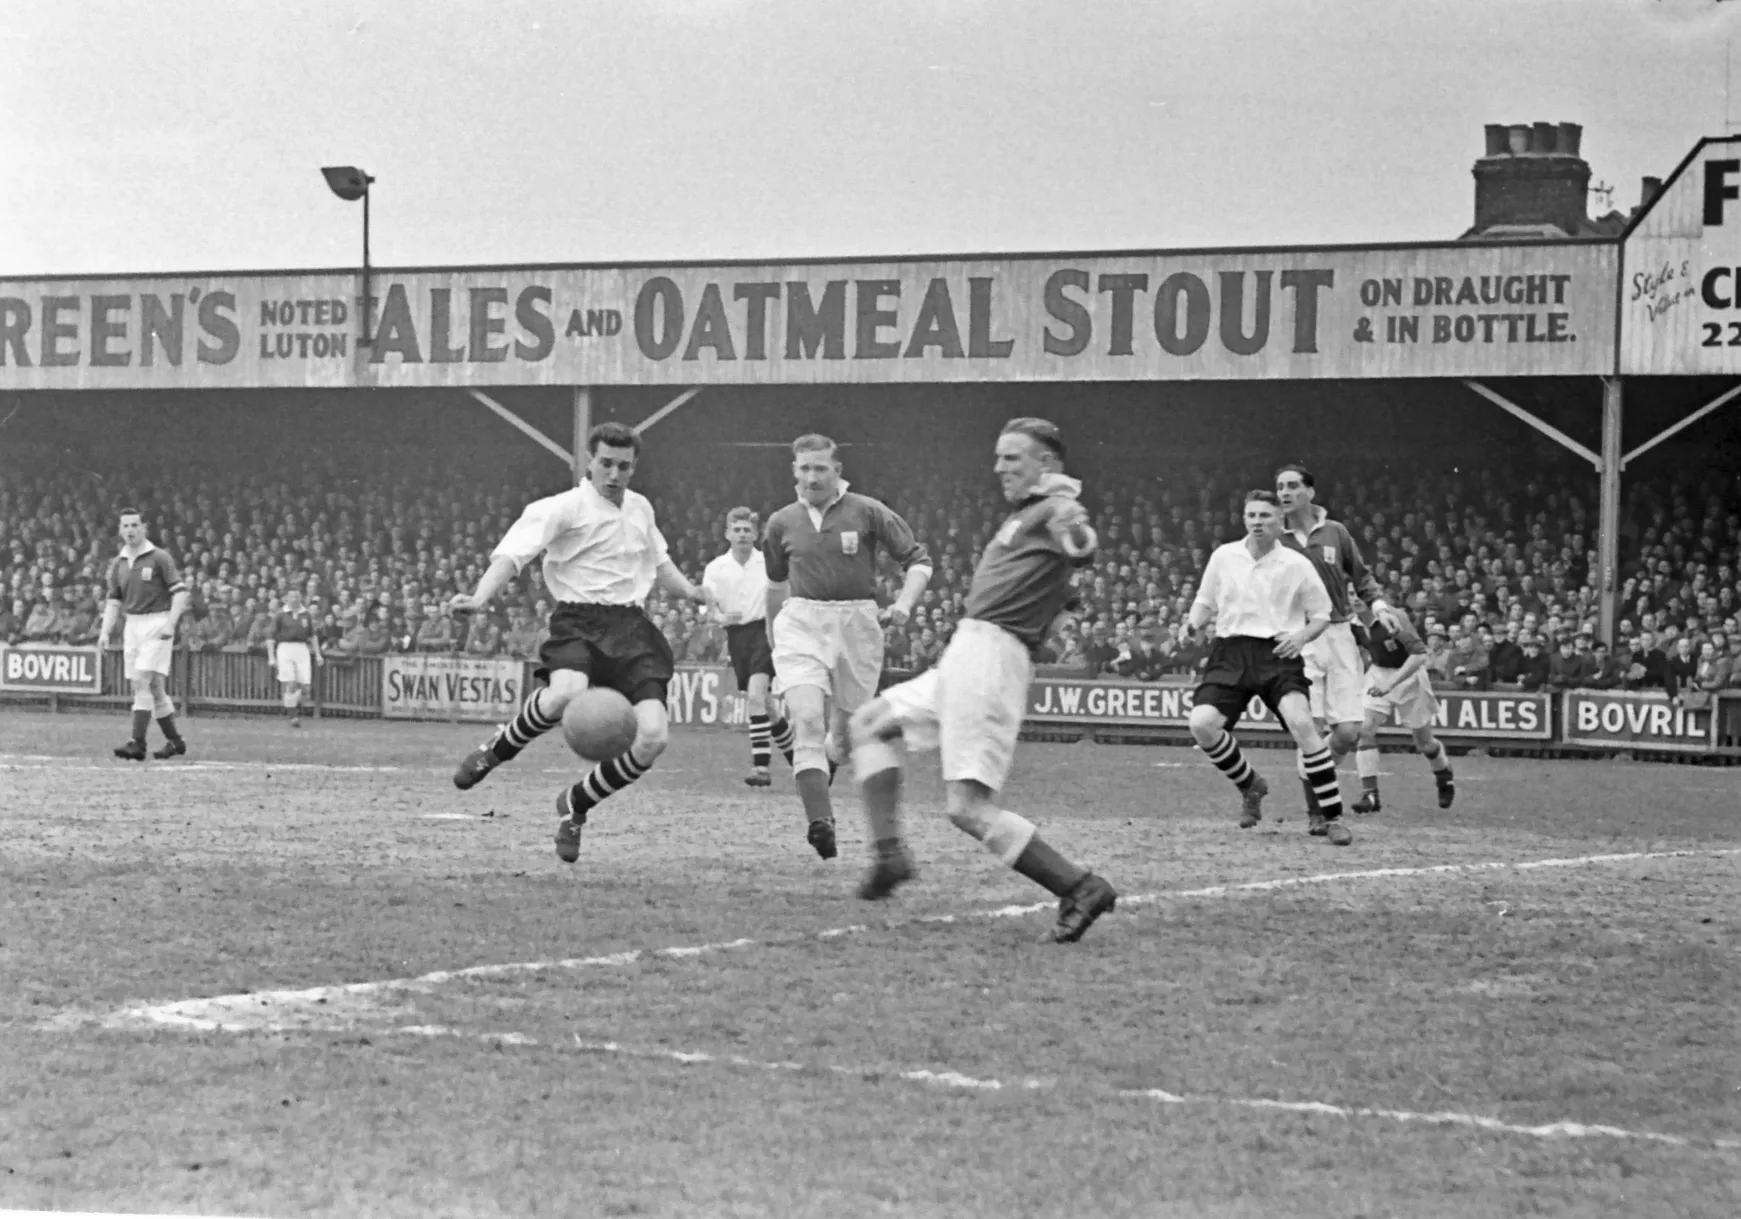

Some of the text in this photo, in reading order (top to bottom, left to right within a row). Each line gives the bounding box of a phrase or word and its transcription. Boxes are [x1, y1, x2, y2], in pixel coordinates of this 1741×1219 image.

[1360, 274, 1571, 306] ON DRAUGHT
[1701, 266, 1741, 310] C
[0, 283, 241, 367] REEN'S
[261, 299, 348, 326] NOTED
[369, 268, 1334, 364] ALES AND OATMEAL STOUT
[1353, 312, 1577, 343] & IN BOTTLE.
[260, 332, 347, 359] LUTON
[8, 653, 93, 681] BOVRIL
[388, 669, 517, 704] SWAN VESTAS
[1458, 699, 1538, 730] ALES
[1578, 700, 1706, 737] BOVRIL
